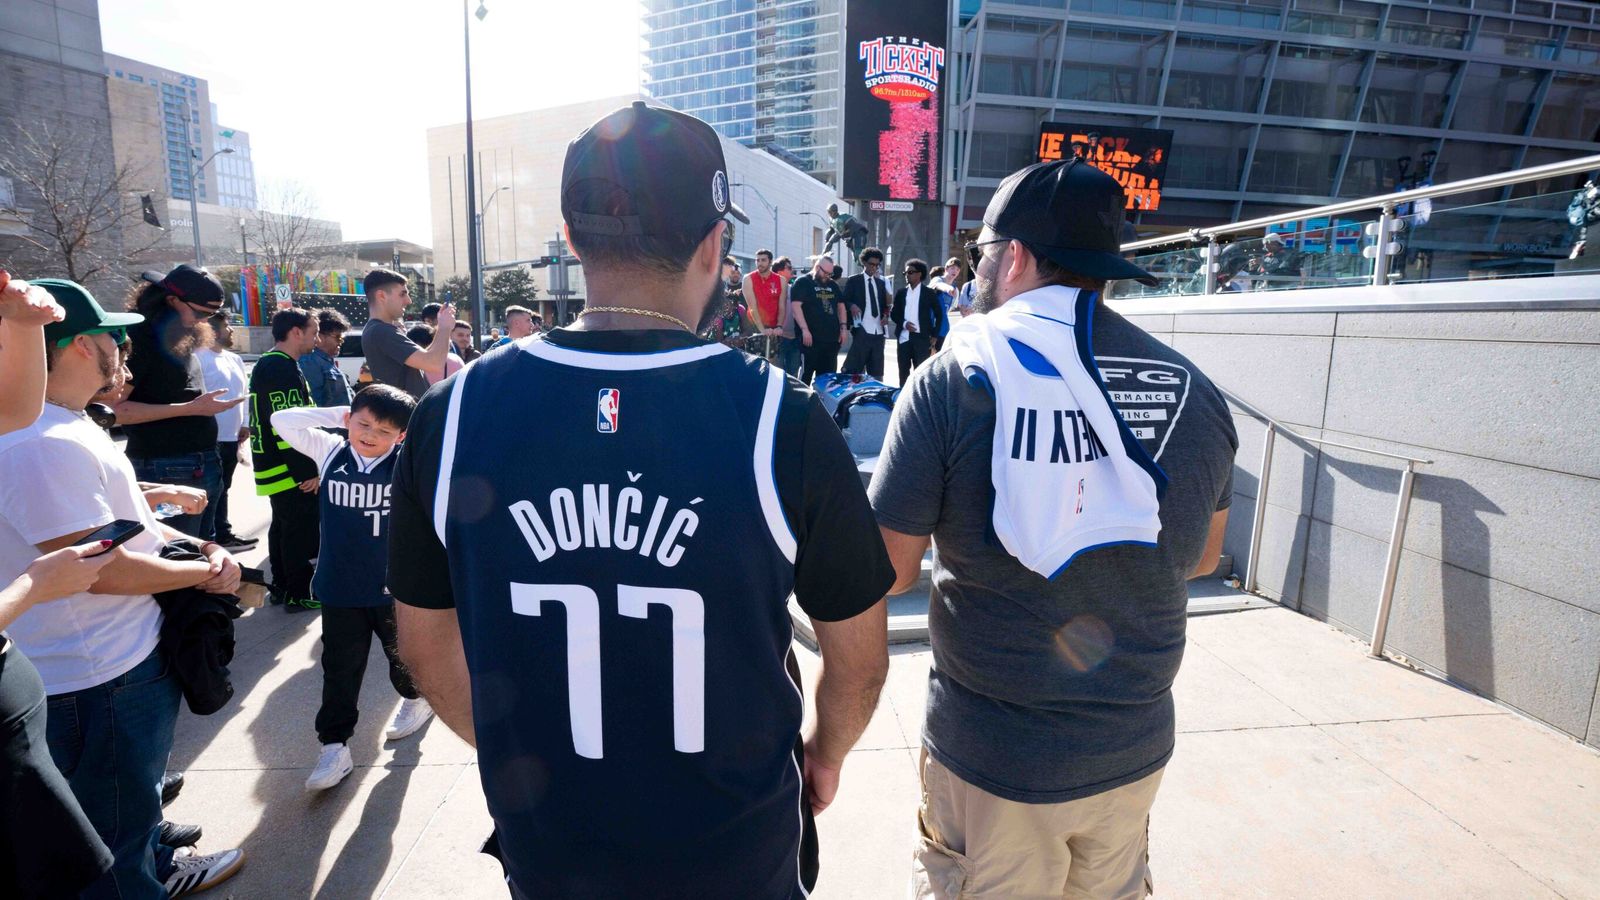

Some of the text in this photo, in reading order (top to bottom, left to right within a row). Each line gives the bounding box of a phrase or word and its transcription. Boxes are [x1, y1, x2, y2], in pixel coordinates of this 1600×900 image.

[859, 37, 945, 83] TICKET
[885, 36, 920, 45] THE
[865, 74, 937, 92] SPORTSRADIO
[508, 470, 705, 567] DONČIĆ
[510, 581, 705, 760] 77
